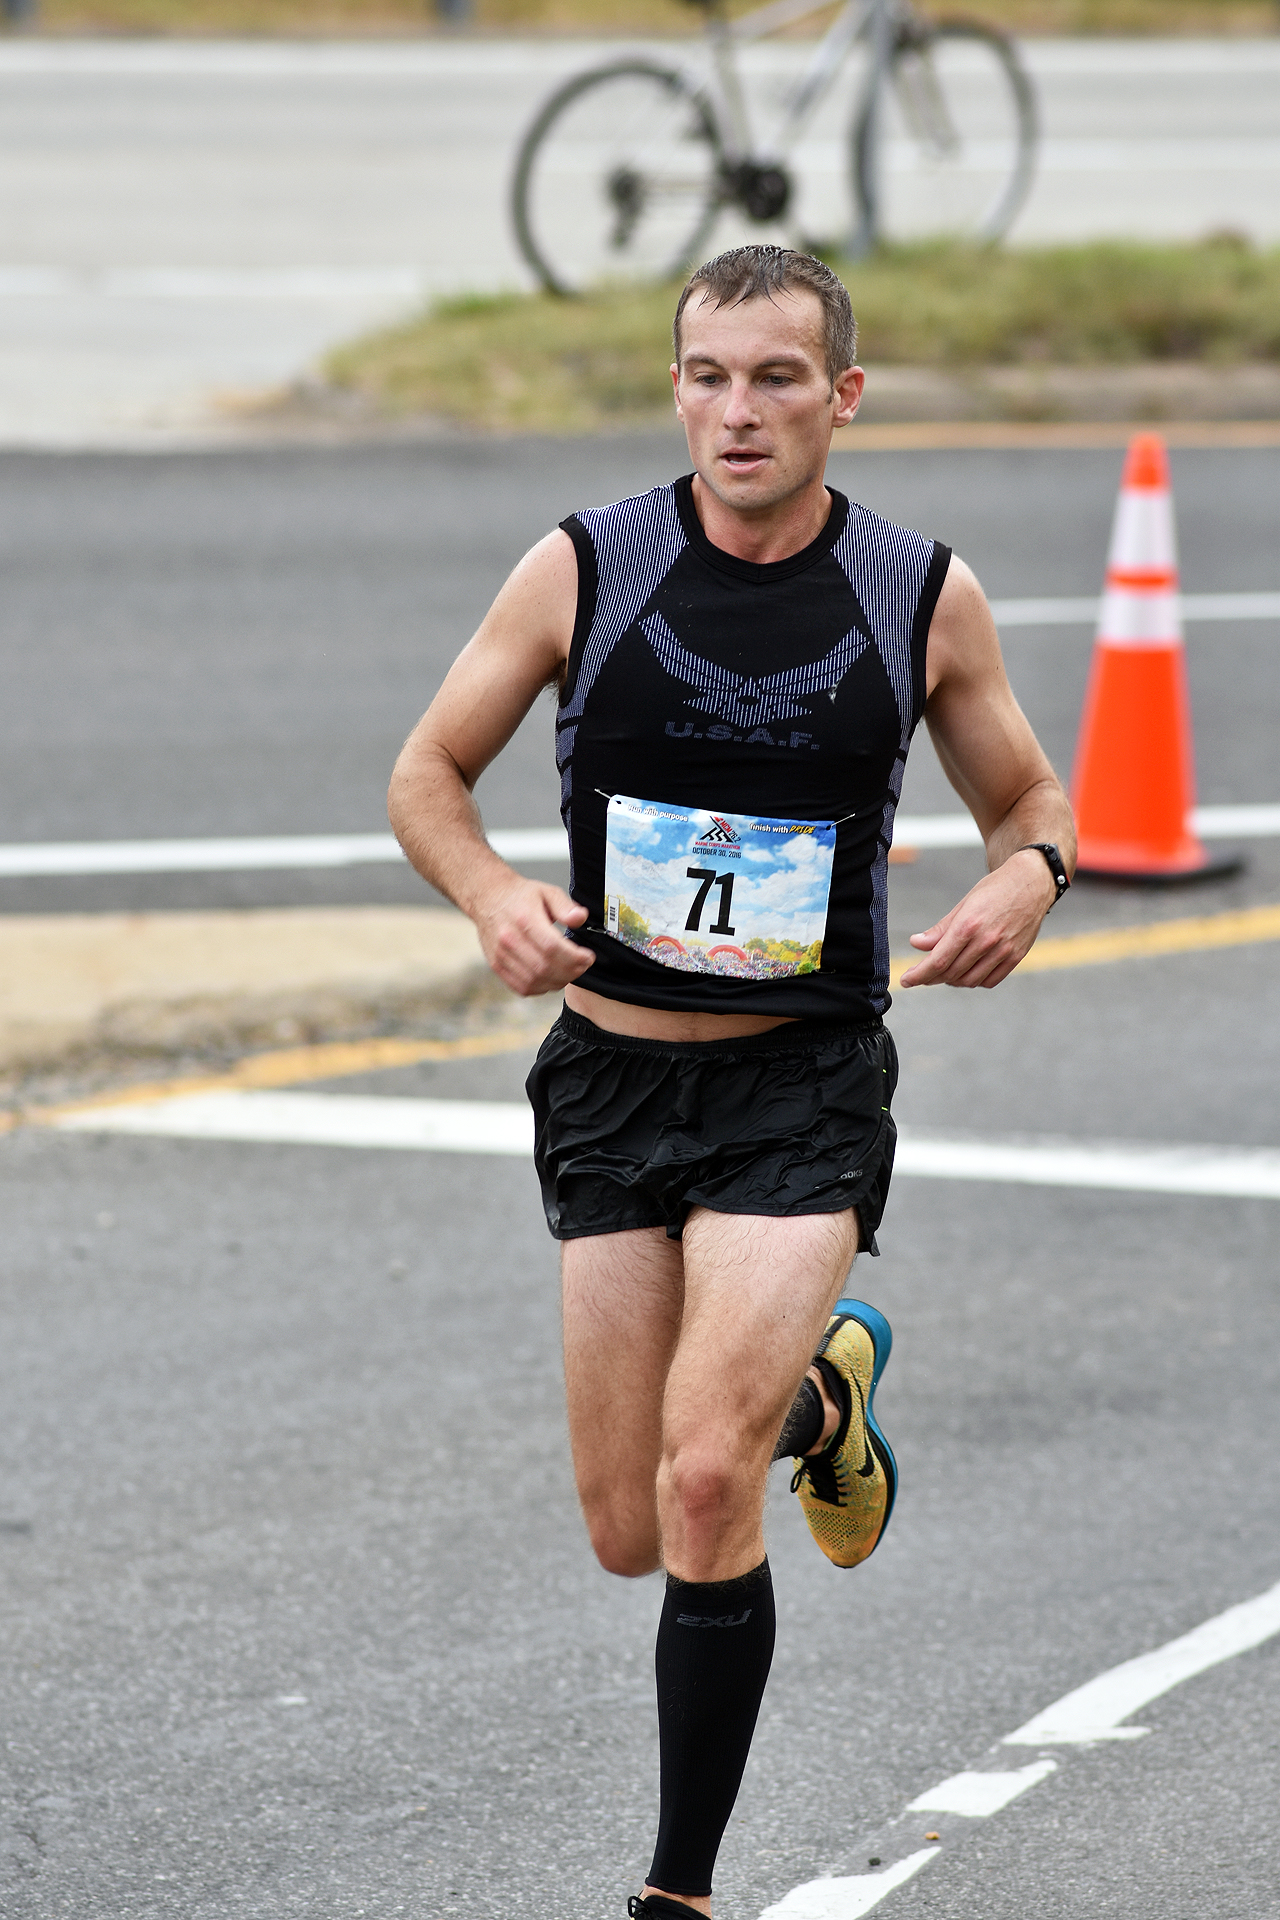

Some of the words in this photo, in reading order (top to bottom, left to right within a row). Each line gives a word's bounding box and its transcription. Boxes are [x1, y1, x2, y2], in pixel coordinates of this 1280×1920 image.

[664, 721, 820, 750] U.S.A.F.
[643, 807, 659, 817] with
[659, 810, 689, 822] purpose
[772, 825, 789, 834] with
[789, 824, 817, 835] PRIDE
[692, 846, 717, 856] OCTOBER
[717, 849, 728, 858] 30,
[728, 850, 742, 859] 2016
[685, 867, 735, 936] 71
[840, 1169, 863, 1180] OOKS
[676, 1608, 753, 1629] 2XU
